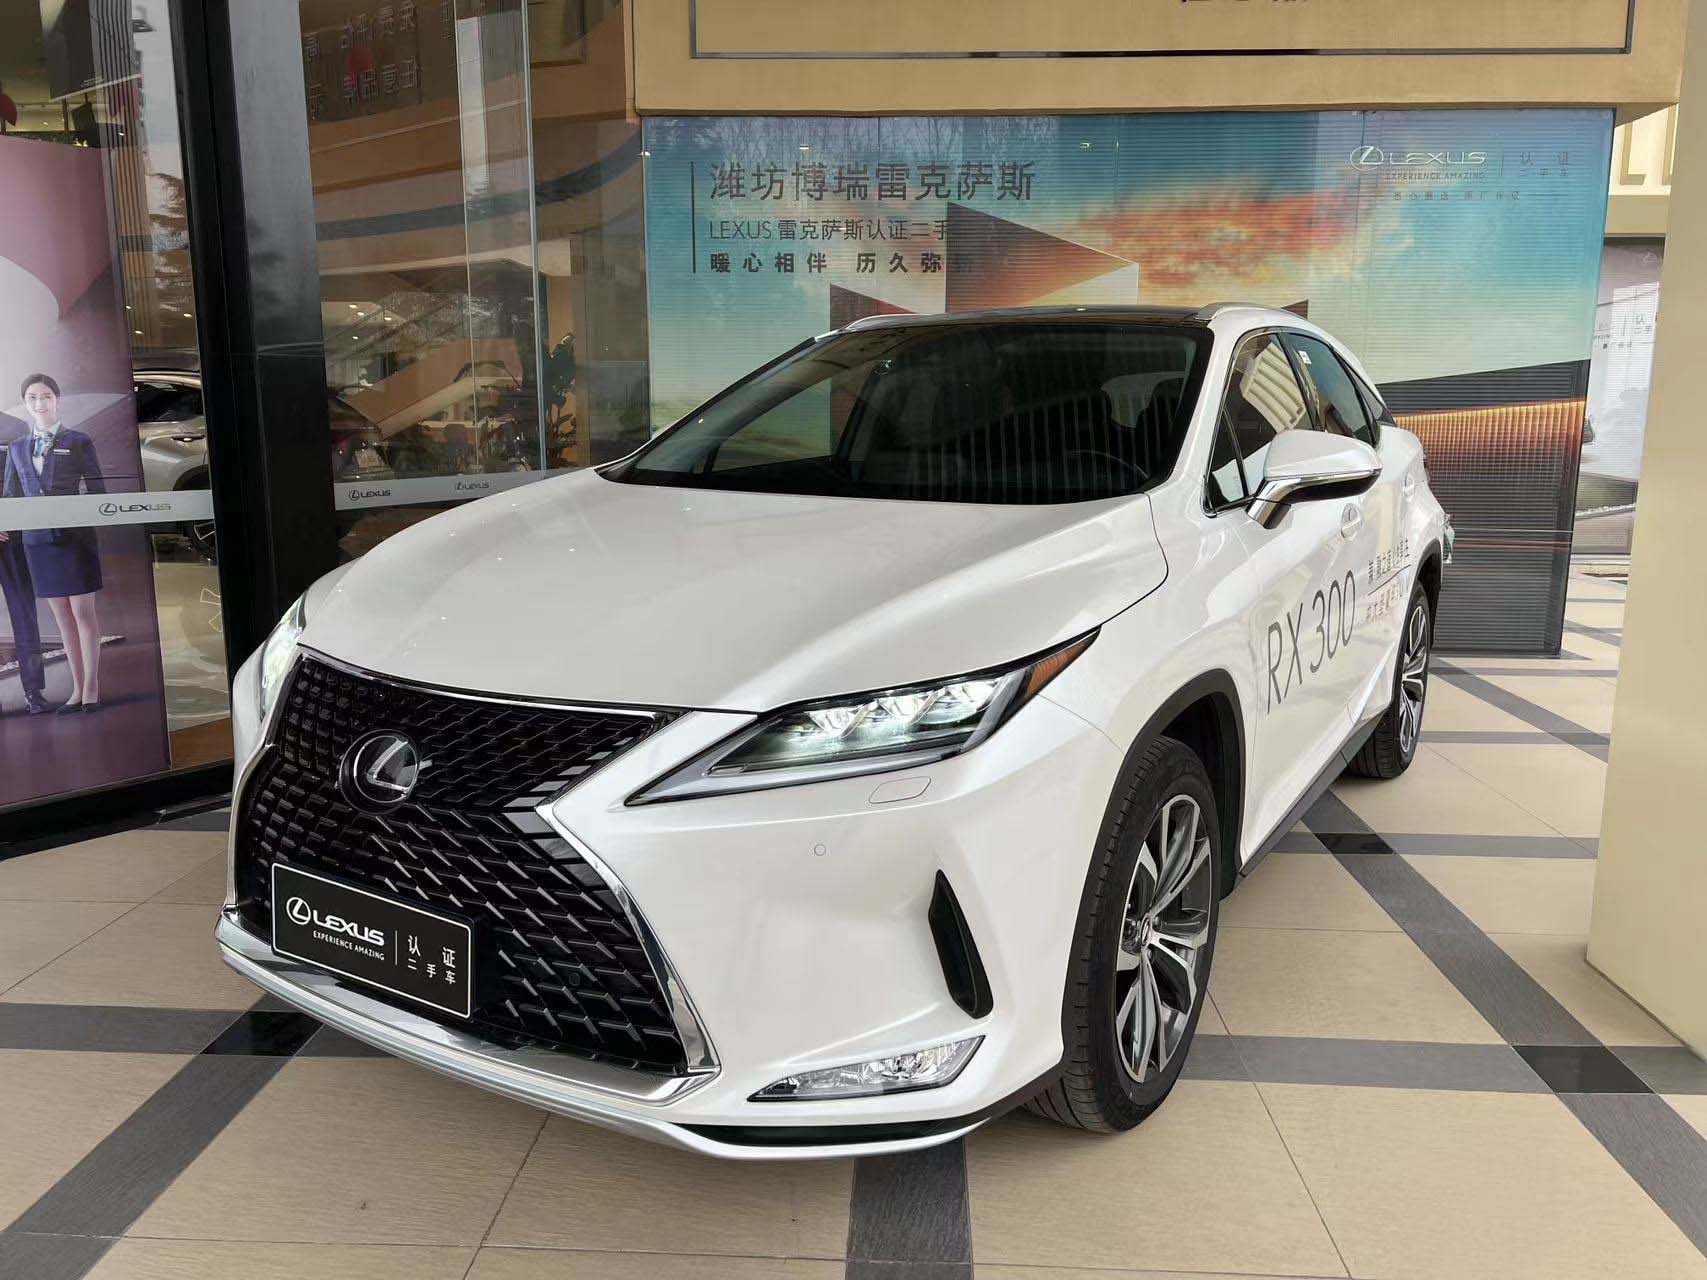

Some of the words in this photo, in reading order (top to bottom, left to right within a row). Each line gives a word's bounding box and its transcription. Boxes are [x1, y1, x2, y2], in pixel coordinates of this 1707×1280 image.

[1388, 151, 1487, 165] LEXUS
[710, 160, 1037, 201] 潍坊博瑞雷克萨斯
[1384, 172, 1441, 180] EXPERIENCE
[1443, 172, 1486, 180] AMAZING
[709, 220, 772, 240] LEXUS
[710, 252, 828, 273] 暖心相伴
[856, 252, 973, 273] 历久弥
[360, 488, 392, 499] LEXUS
[464, 482, 490, 490] LEXUS
[119, 503, 172, 513] LEXUS
[1267, 602, 1304, 715] RX
[1310, 570, 1356, 674] 300
[312, 909, 385, 947] LEXUS
[312, 930, 354, 952] EXPERIENCE
[354, 943, 385, 962] AMAZING
[407, 935, 457, 969] 认证
[407, 958, 456, 985] 二手车
